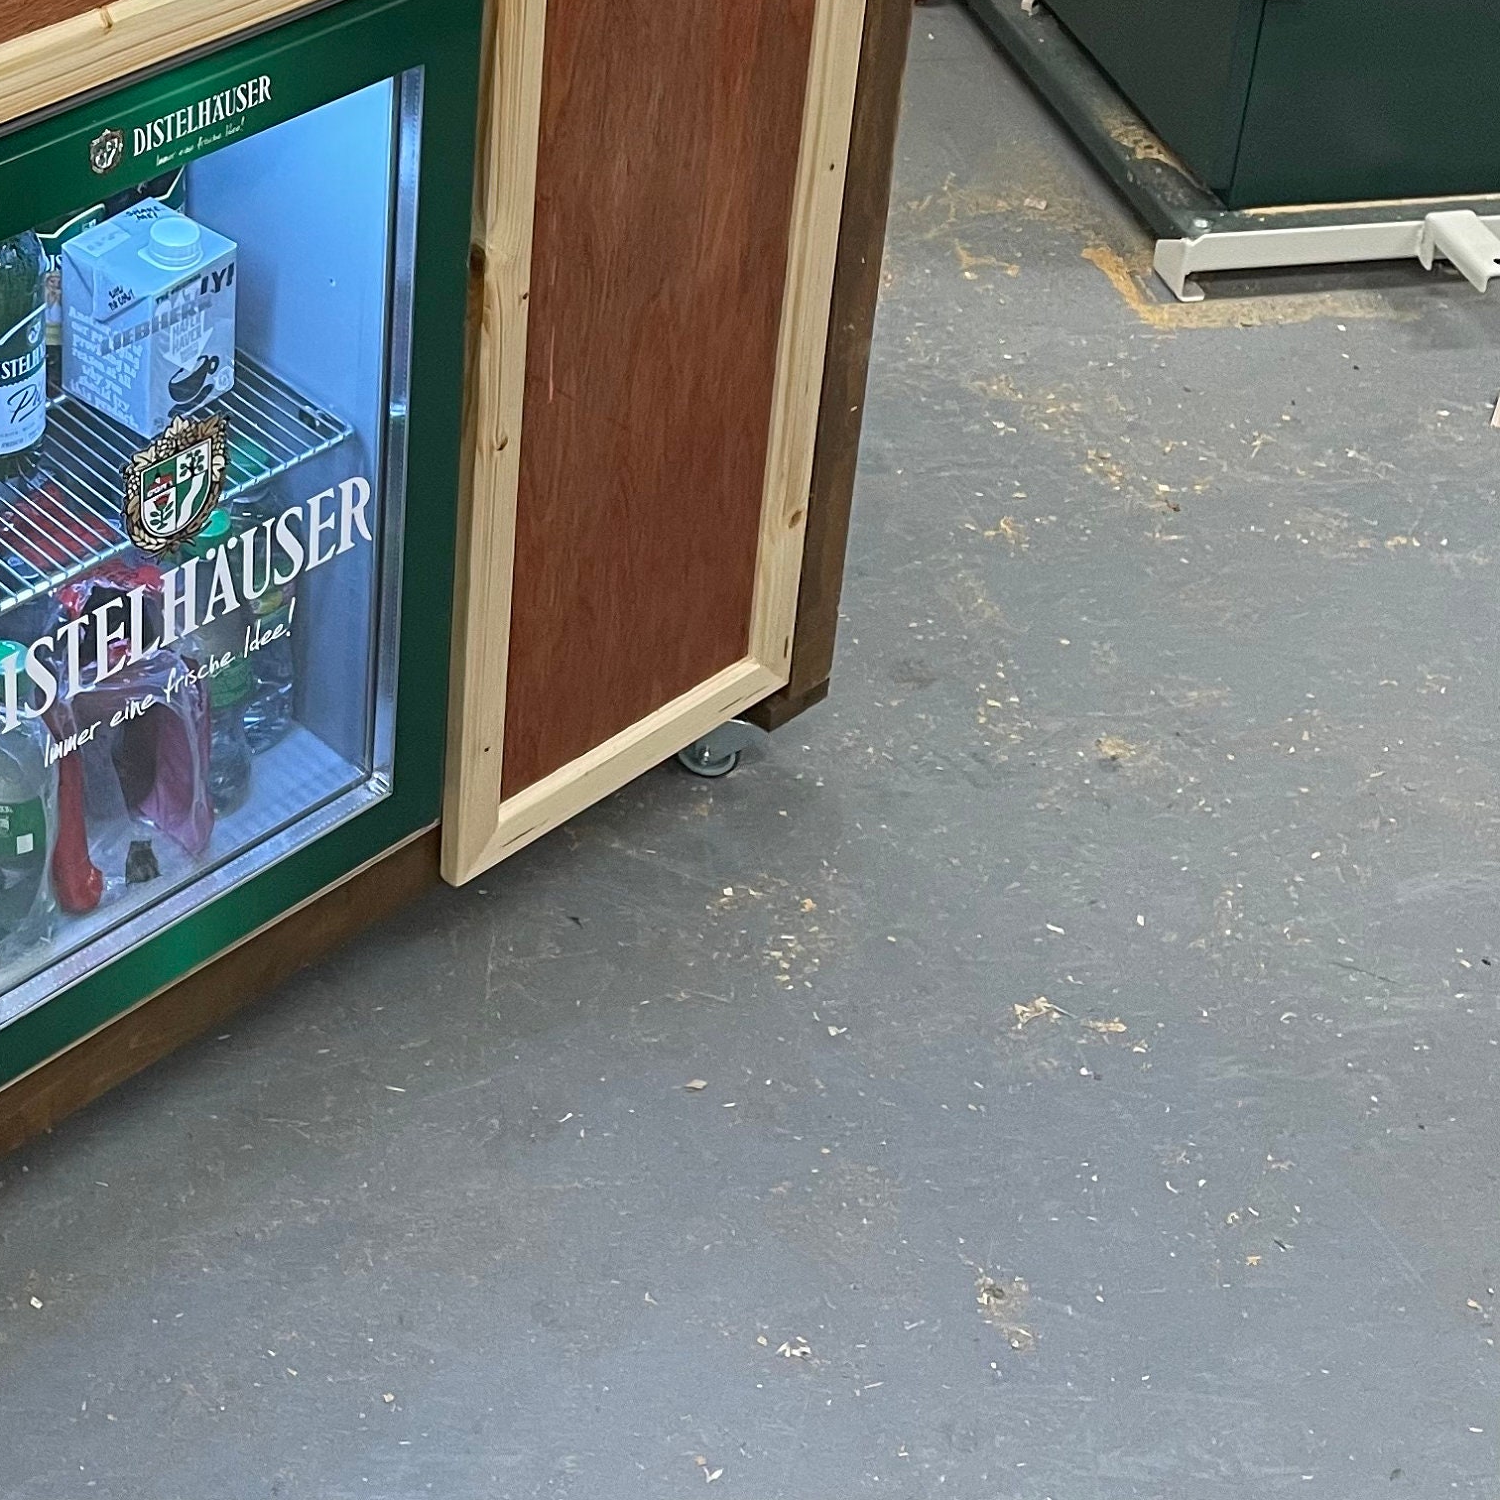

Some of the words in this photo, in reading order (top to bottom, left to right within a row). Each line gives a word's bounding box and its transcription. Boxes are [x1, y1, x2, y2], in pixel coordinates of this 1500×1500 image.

[133, 75, 272, 157] DISTELHÄUSER
[43, 719, 102, 768] Immer
[109, 693, 157, 728] eine
[163, 651, 236, 704] frische
[244, 598, 297, 659] Idee!
